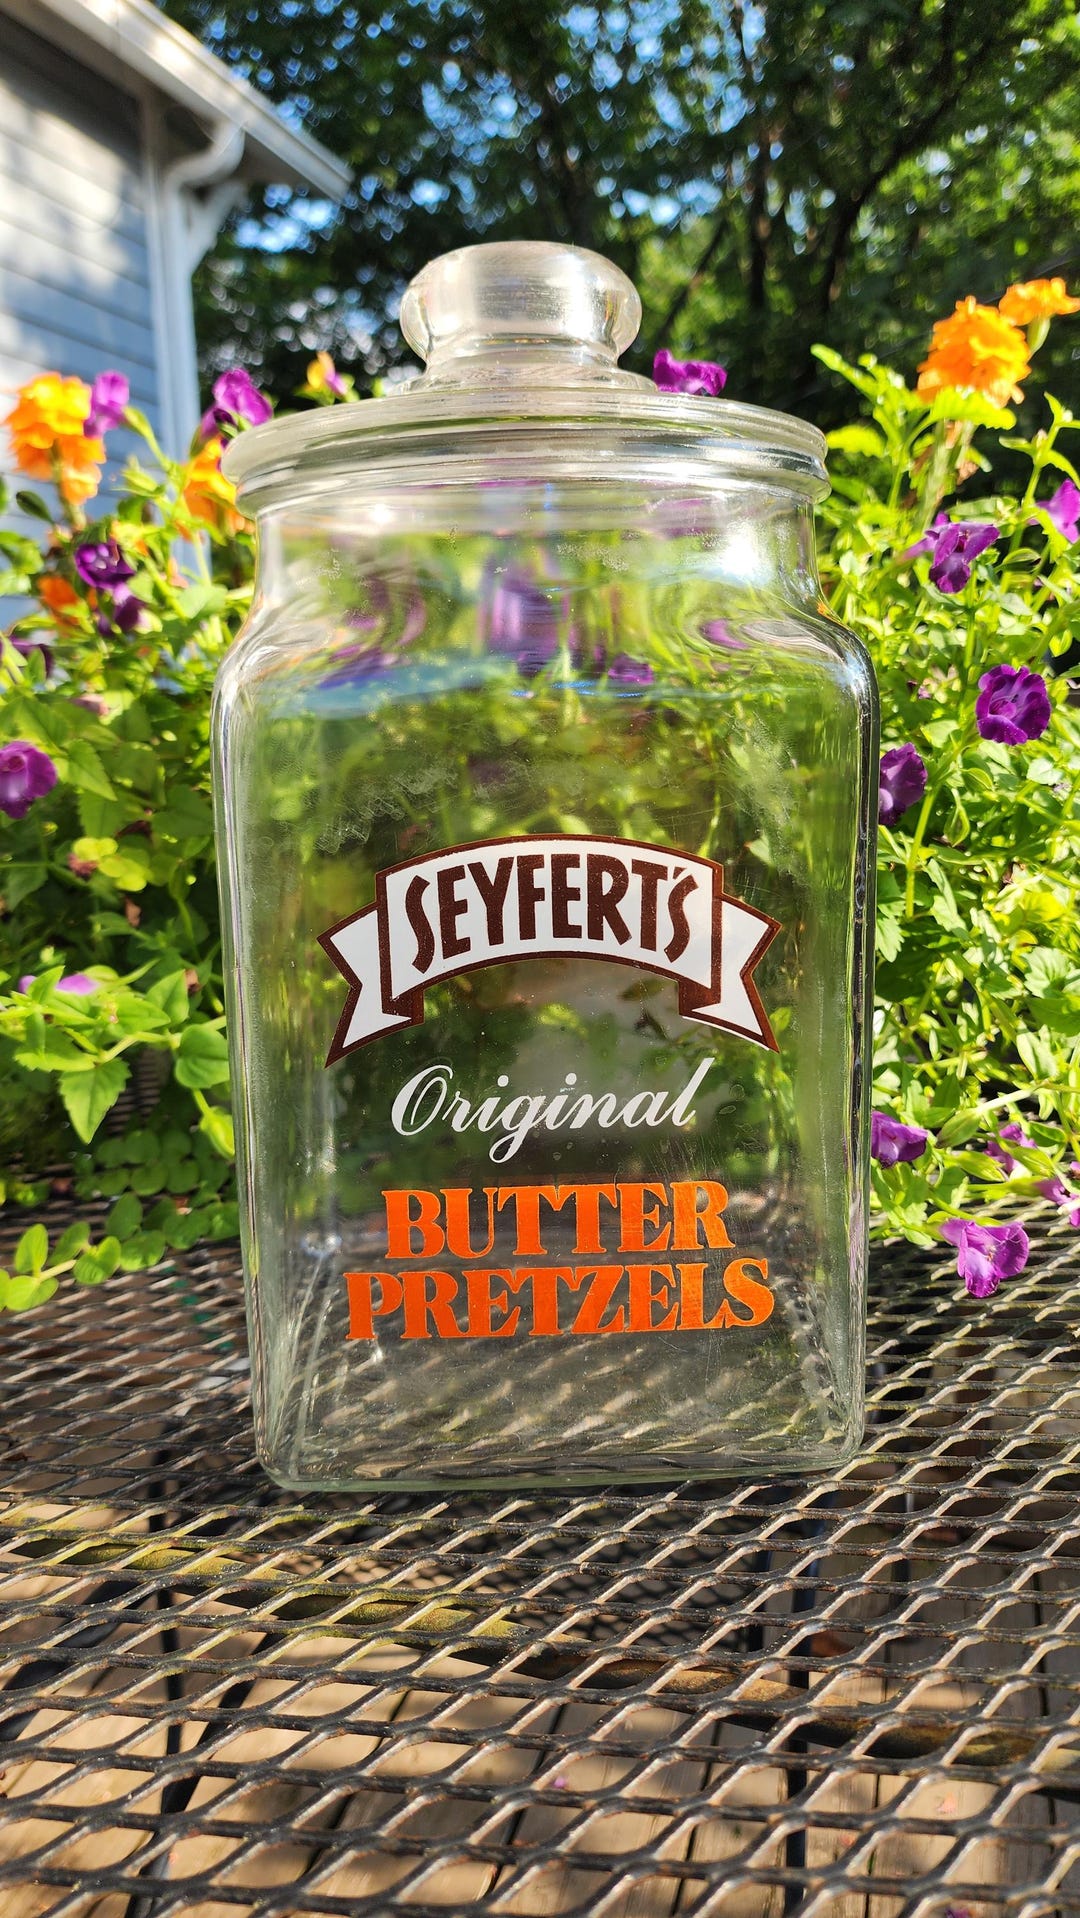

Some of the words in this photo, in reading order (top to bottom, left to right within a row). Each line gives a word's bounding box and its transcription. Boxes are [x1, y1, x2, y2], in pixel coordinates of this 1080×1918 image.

[405, 853, 699, 974] SEYFERT'S
[391, 1057, 715, 1163] Original
[382, 1180, 735, 1259] BUTTER
[344, 1258, 775, 1341] PRETZELS
